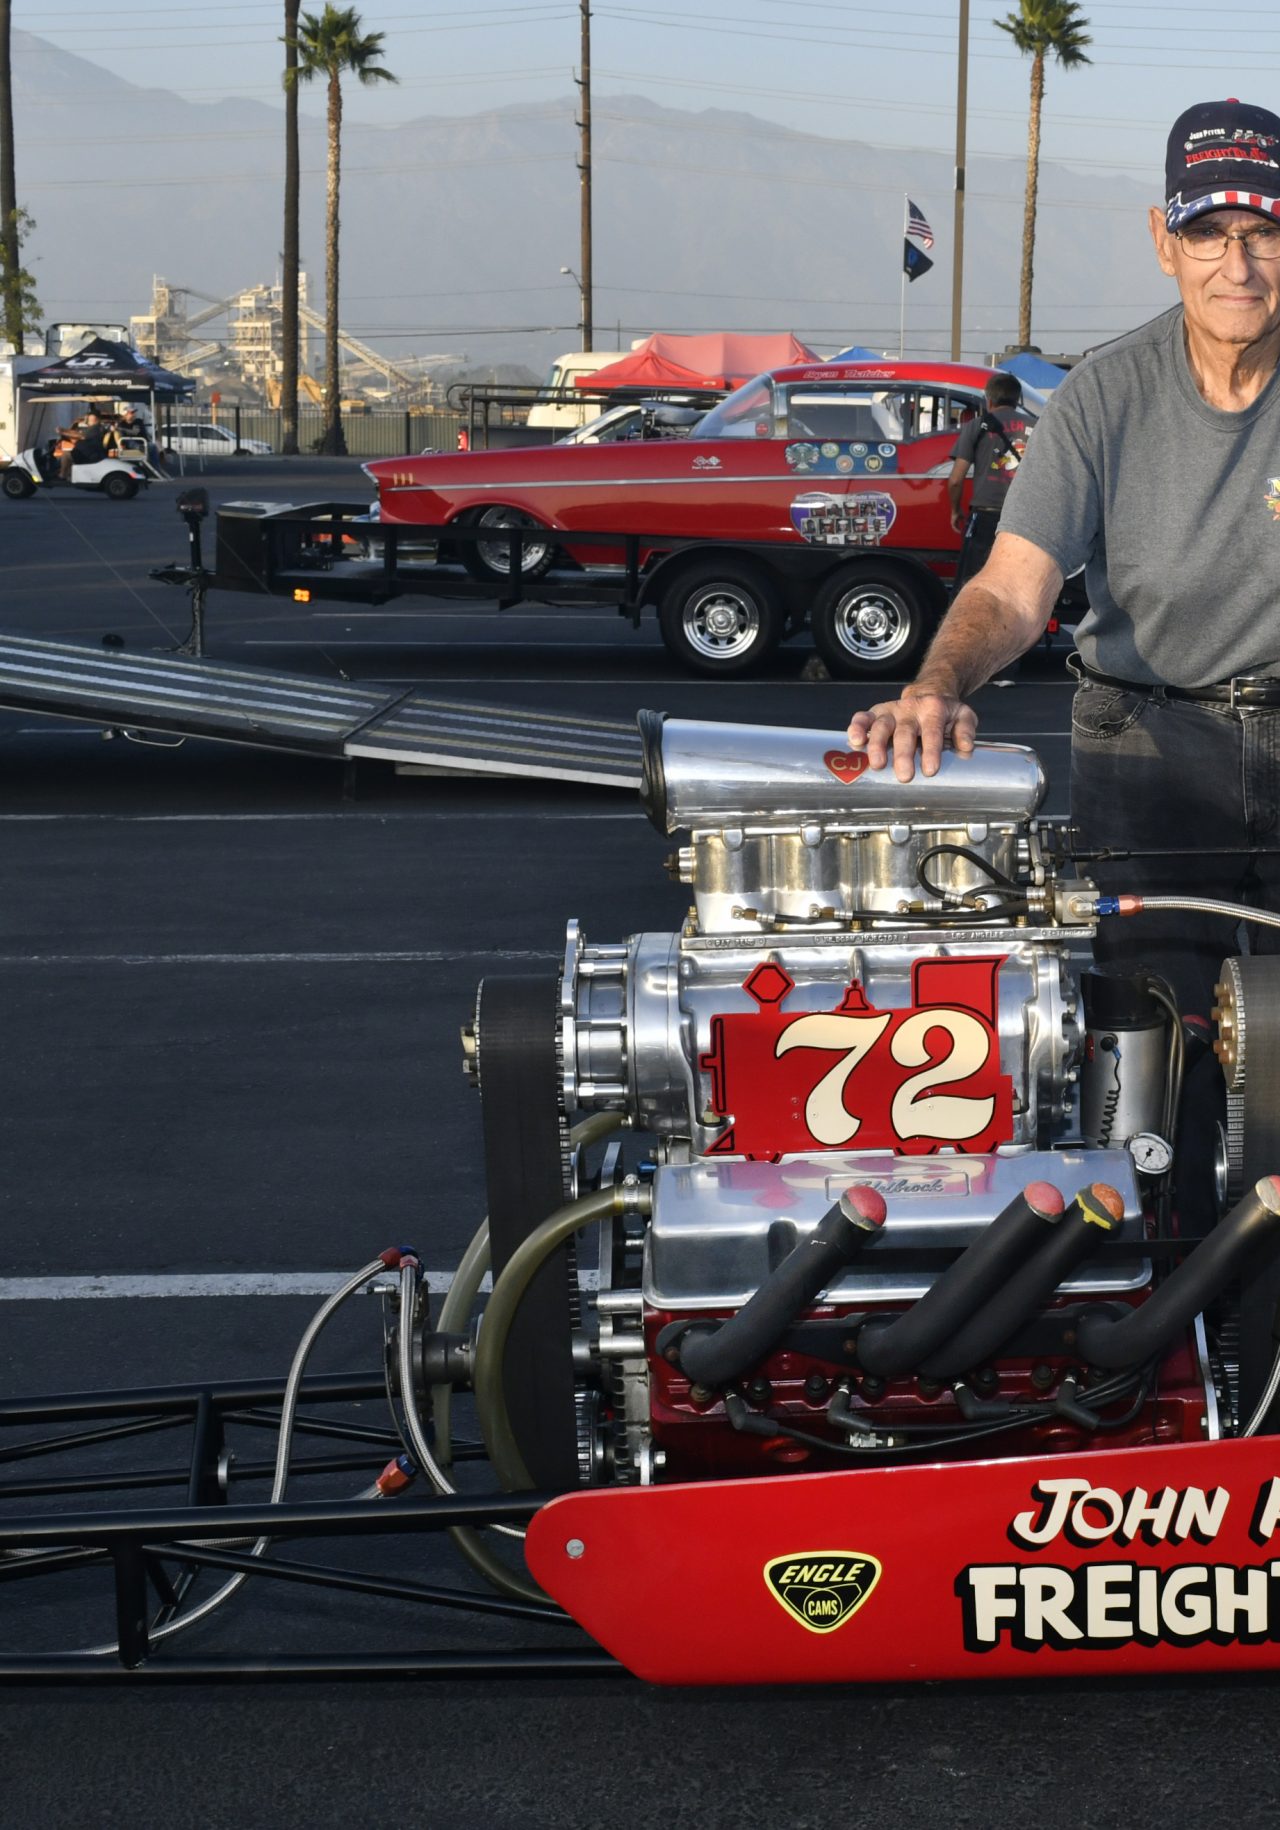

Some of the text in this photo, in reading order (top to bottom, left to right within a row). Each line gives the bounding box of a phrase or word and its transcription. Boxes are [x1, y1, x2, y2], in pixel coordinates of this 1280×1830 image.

[829, 754, 863, 772] CJ
[774, 1008, 997, 1147] 72
[1010, 1477, 1231, 1547] JOHN
[778, 1562, 866, 1584] ENGLE
[807, 1599, 838, 1616] CAMS
